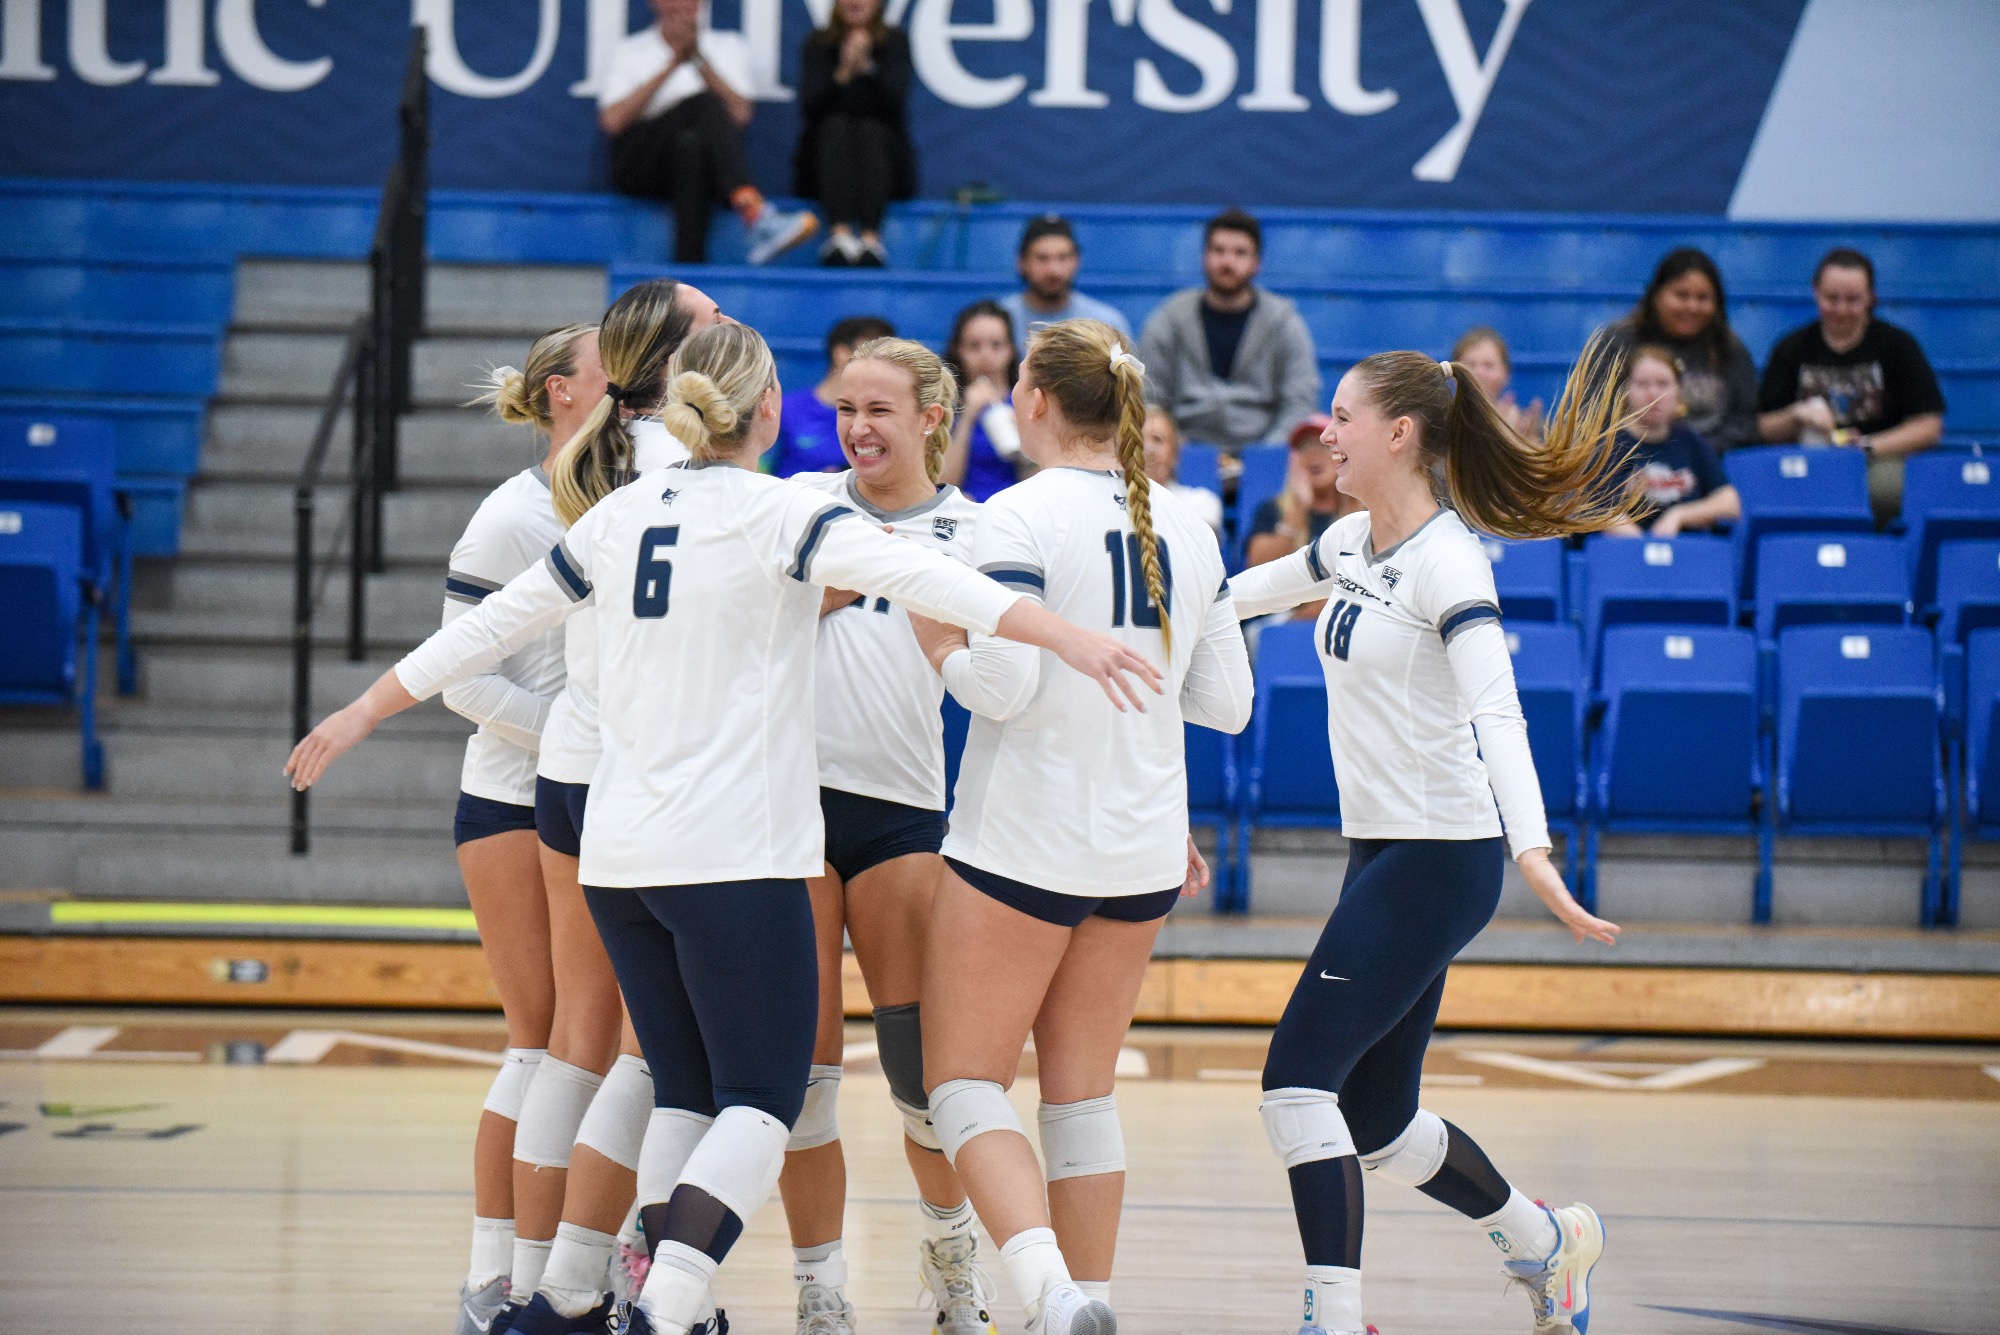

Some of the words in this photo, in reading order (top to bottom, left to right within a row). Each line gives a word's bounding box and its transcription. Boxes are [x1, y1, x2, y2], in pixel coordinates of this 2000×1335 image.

[935, 518, 955, 529] SSC
[632, 523, 681, 620] 6
[1104, 528, 1173, 630] 10
[1384, 567, 1401, 580] SSC
[1324, 598, 1363, 662] 18
